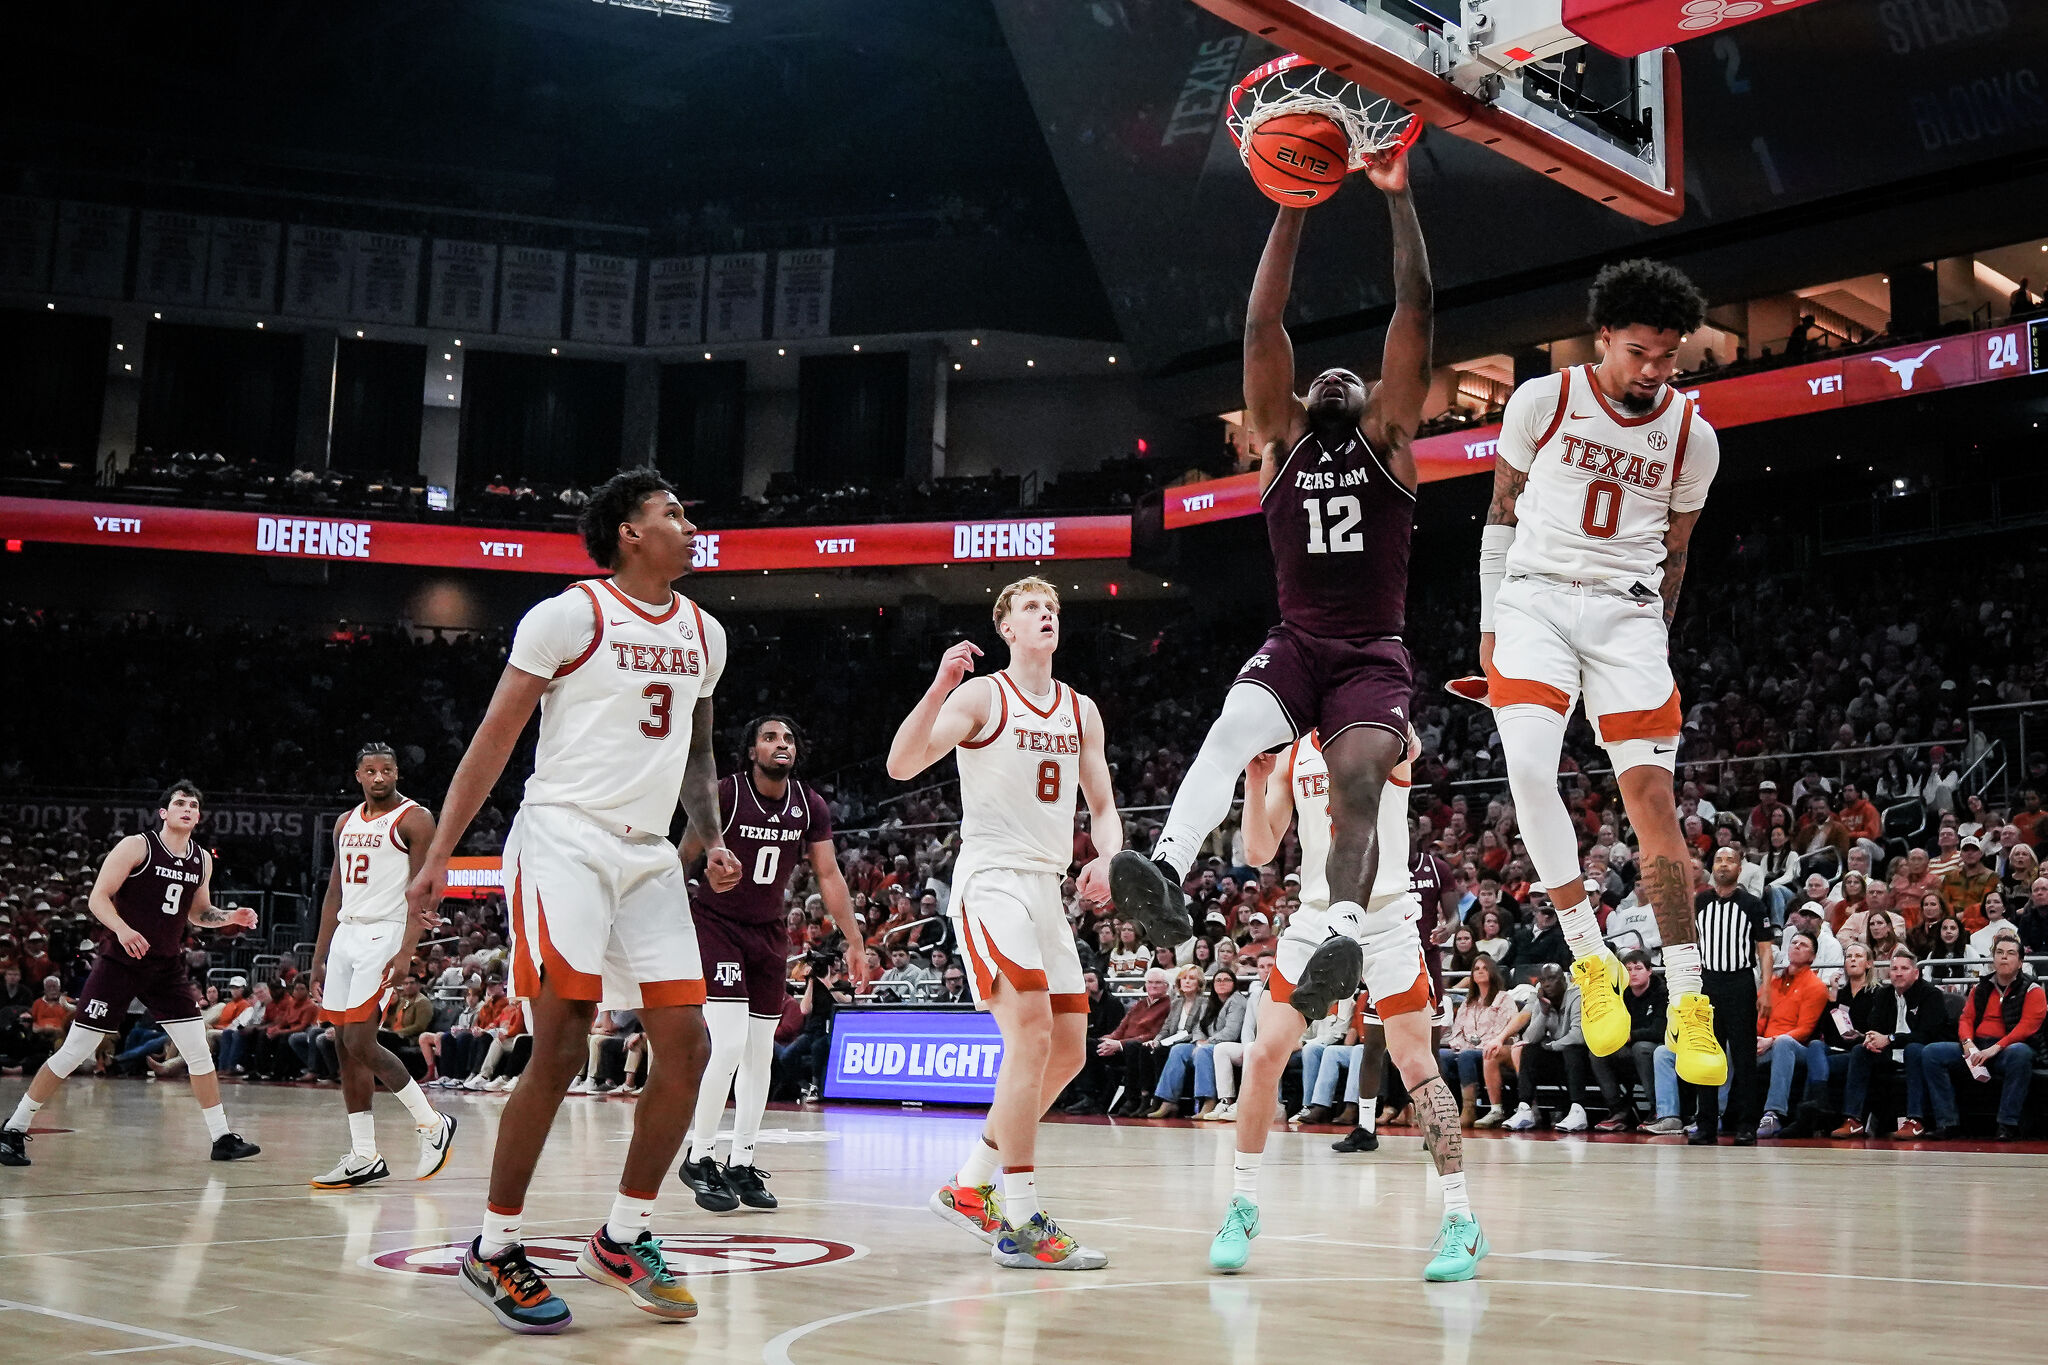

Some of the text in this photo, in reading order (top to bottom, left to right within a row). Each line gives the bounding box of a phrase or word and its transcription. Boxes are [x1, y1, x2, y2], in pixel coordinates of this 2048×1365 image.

[1161, 35, 1243, 146] TEXAS
[1276, 146, 1330, 175] ELITE
[1987, 333, 2019, 370] 24
[1808, 374, 1843, 395] YET
[1464, 439, 1498, 460] YET
[1561, 432, 1667, 490] TEXAS
[1294, 470, 1335, 491] TEAS
[1182, 493, 1215, 513] YETI
[1580, 476, 1625, 541] 0
[93, 516, 141, 533] YETI
[256, 517, 371, 558] DEFENSE
[1303, 495, 1364, 553] 12
[480, 541, 523, 558] YETI
[815, 538, 855, 554] YETI
[954, 522, 1056, 559] DEFENSE
[610, 640, 700, 677] TEXAS
[638, 681, 674, 740] 3
[1013, 727, 1080, 755] TEXAS
[1036, 758, 1062, 804] 8
[341, 833, 384, 849] TEXAS
[739, 825, 779, 841] TEXAS
[155, 866, 183, 881] TEXAS
[345, 853, 369, 885] 12
[446, 869, 504, 887] ONGHORNS
[753, 846, 781, 885] 0
[161, 883, 184, 915] 9
[843, 1042, 1000, 1078] BUD LIGHT
